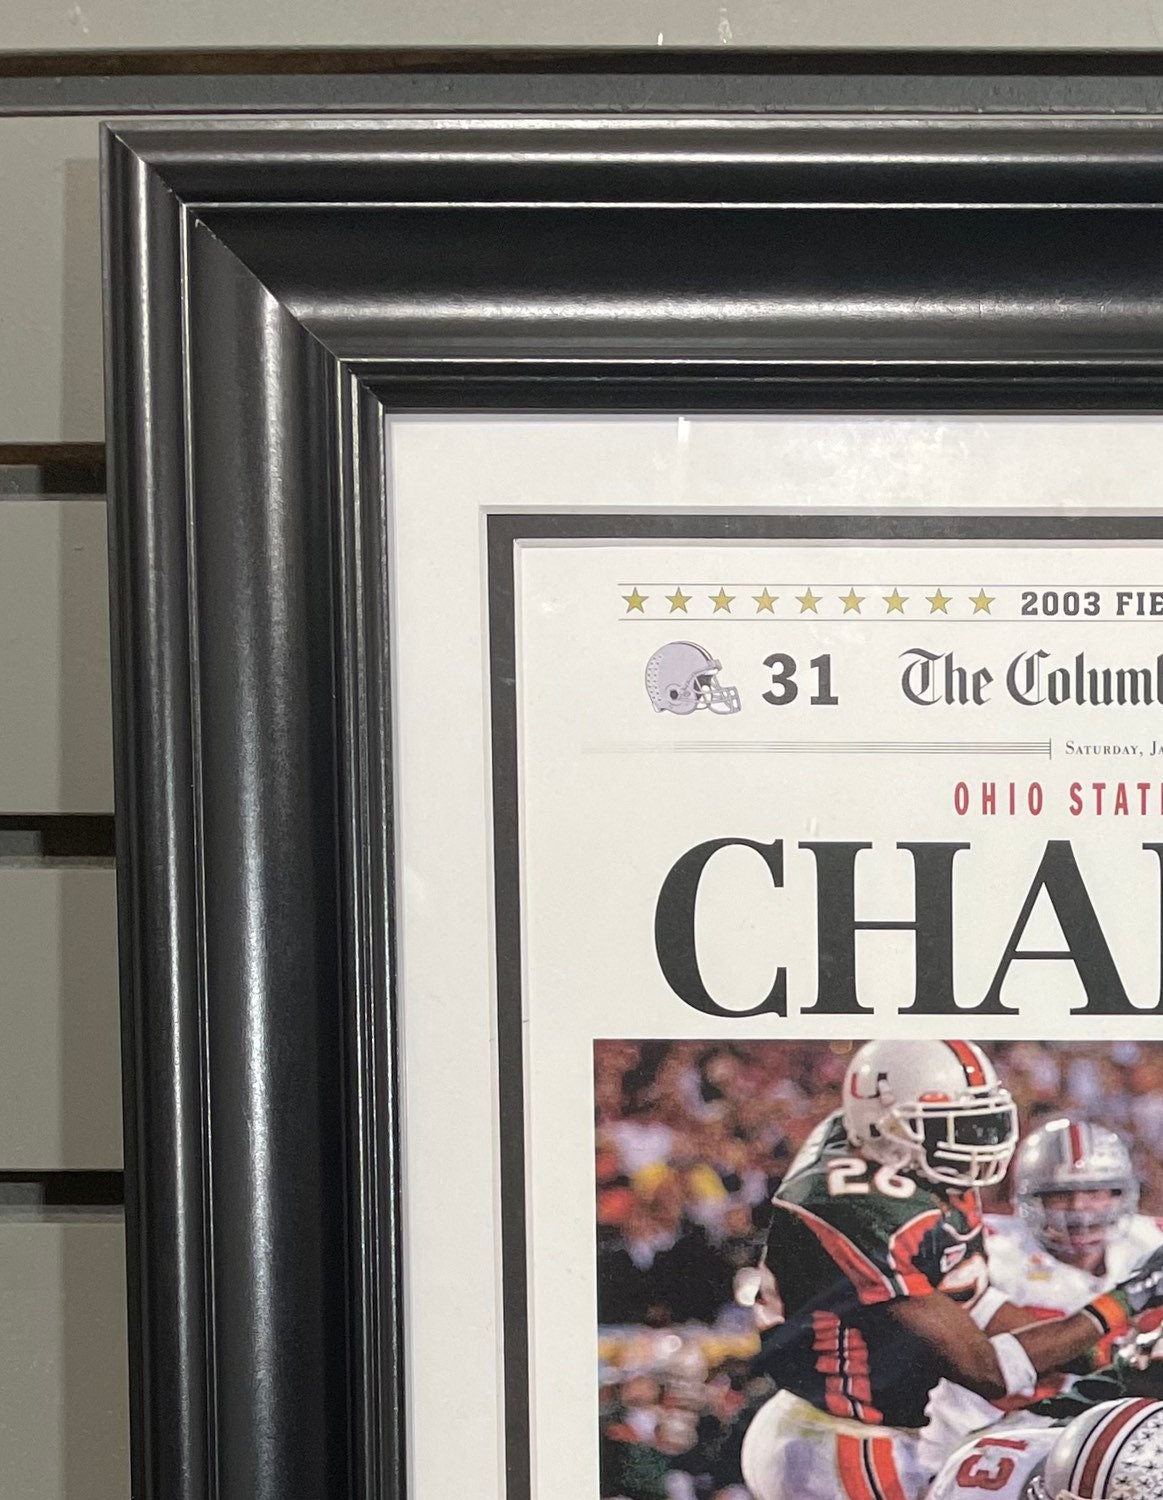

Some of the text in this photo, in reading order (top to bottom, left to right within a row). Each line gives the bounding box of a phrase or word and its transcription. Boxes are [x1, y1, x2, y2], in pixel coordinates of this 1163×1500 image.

[1022, 592, 1100, 616] 2003
[762, 653, 838, 705] 31
[899, 648, 993, 705] The
[955, 782, 1042, 815] OHIO
[826, 1157, 917, 1199] 26
[954, 1437, 1029, 1491] 13
